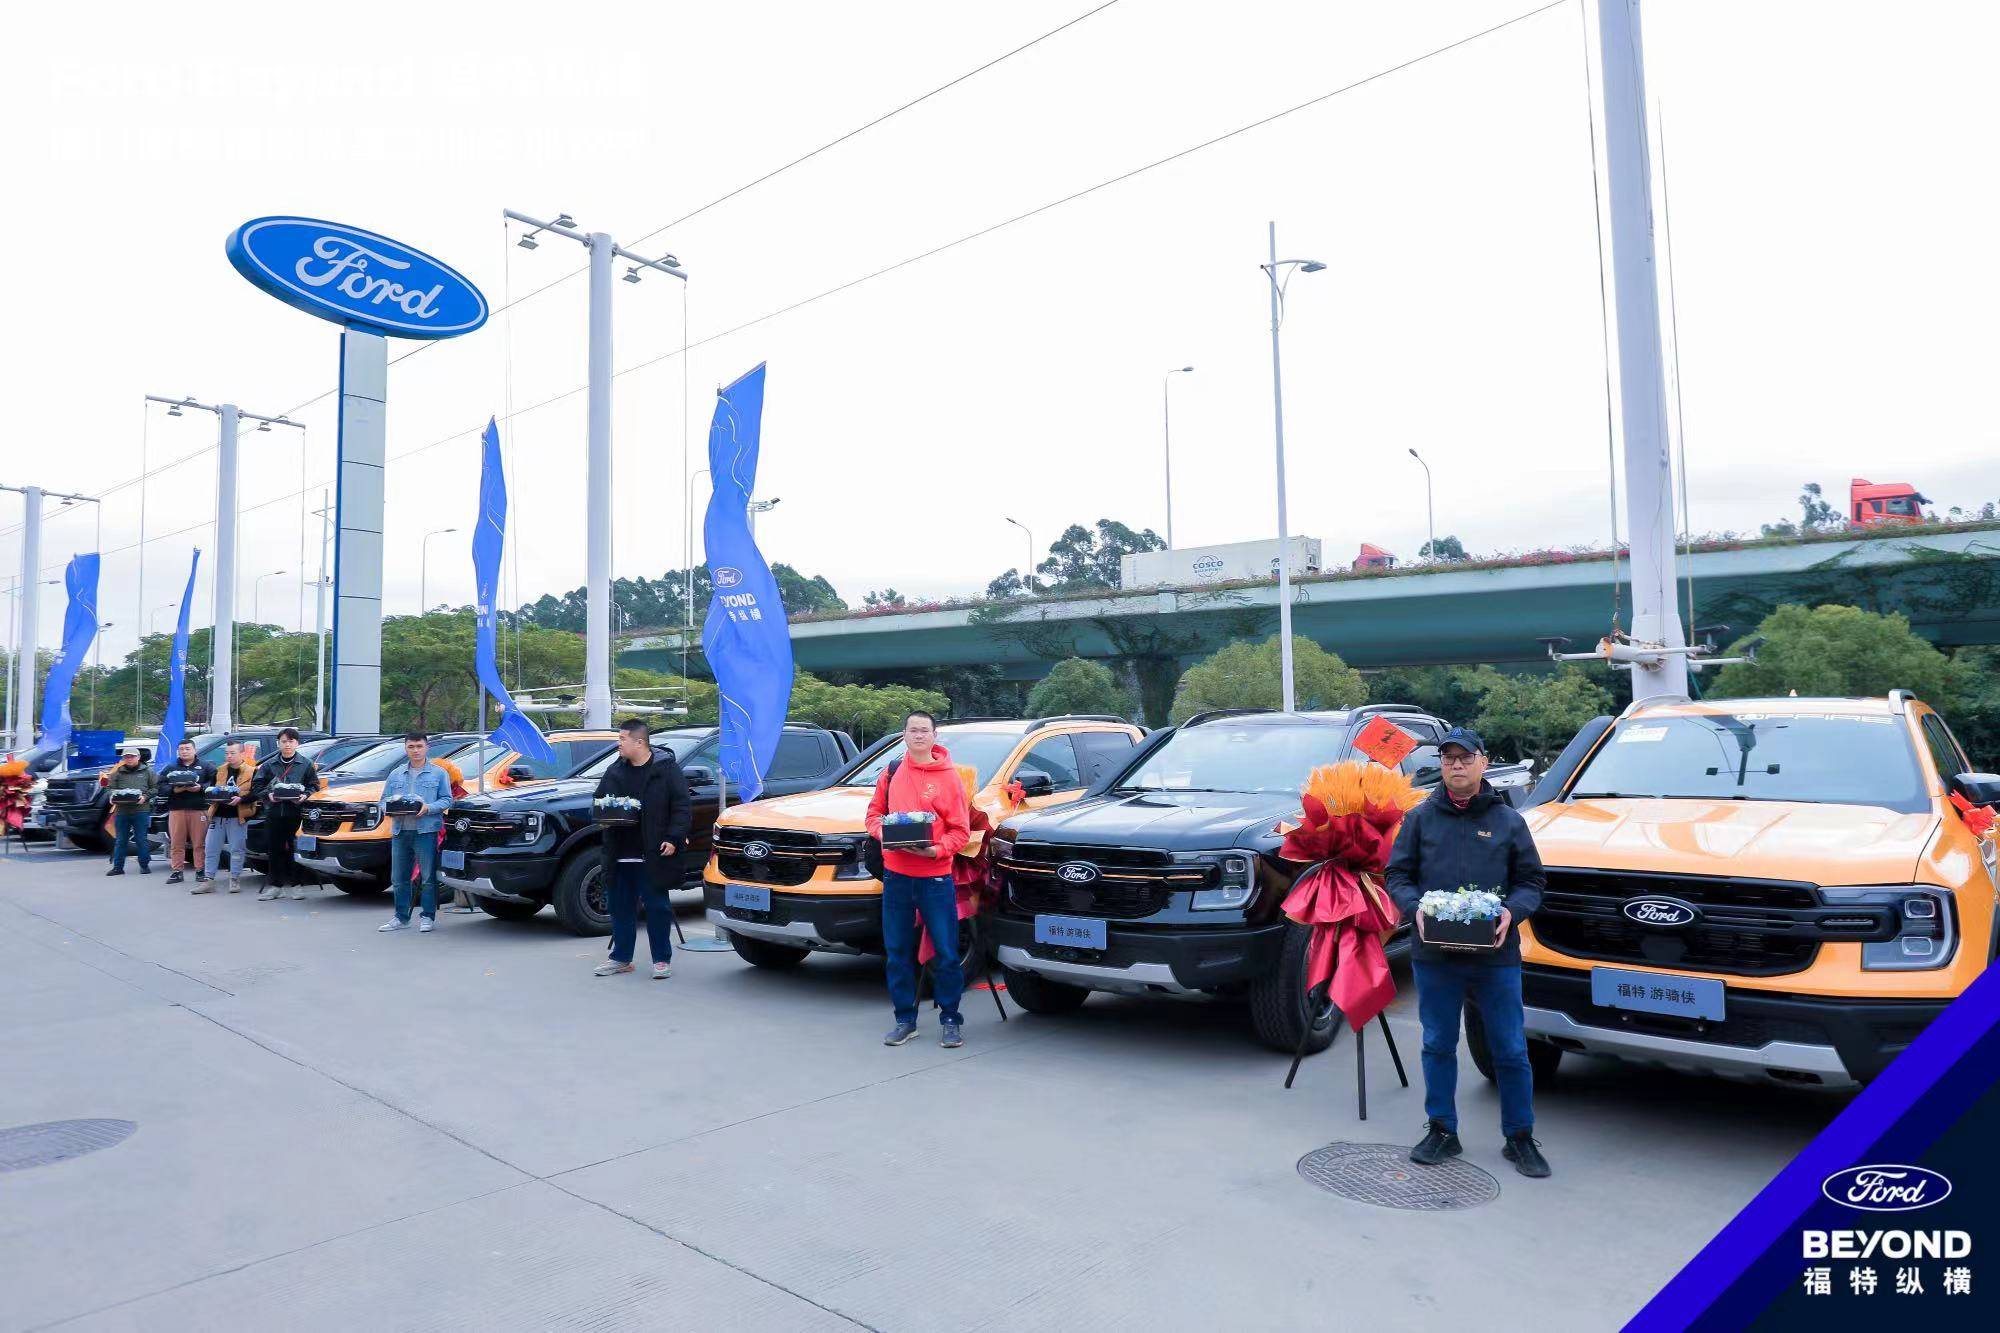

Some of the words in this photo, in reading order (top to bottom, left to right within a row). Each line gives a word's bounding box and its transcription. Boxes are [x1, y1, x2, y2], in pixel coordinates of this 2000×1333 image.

[295, 236, 444, 319] Ford
[1192, 561, 1224, 570] COSCO
[717, 570, 736, 584] Ford
[1064, 866, 1088, 880] Ford
[1637, 903, 1680, 921] Ford
[1617, 983, 1646, 999] 福特
[1650, 986, 1696, 1005] 游骑侠
